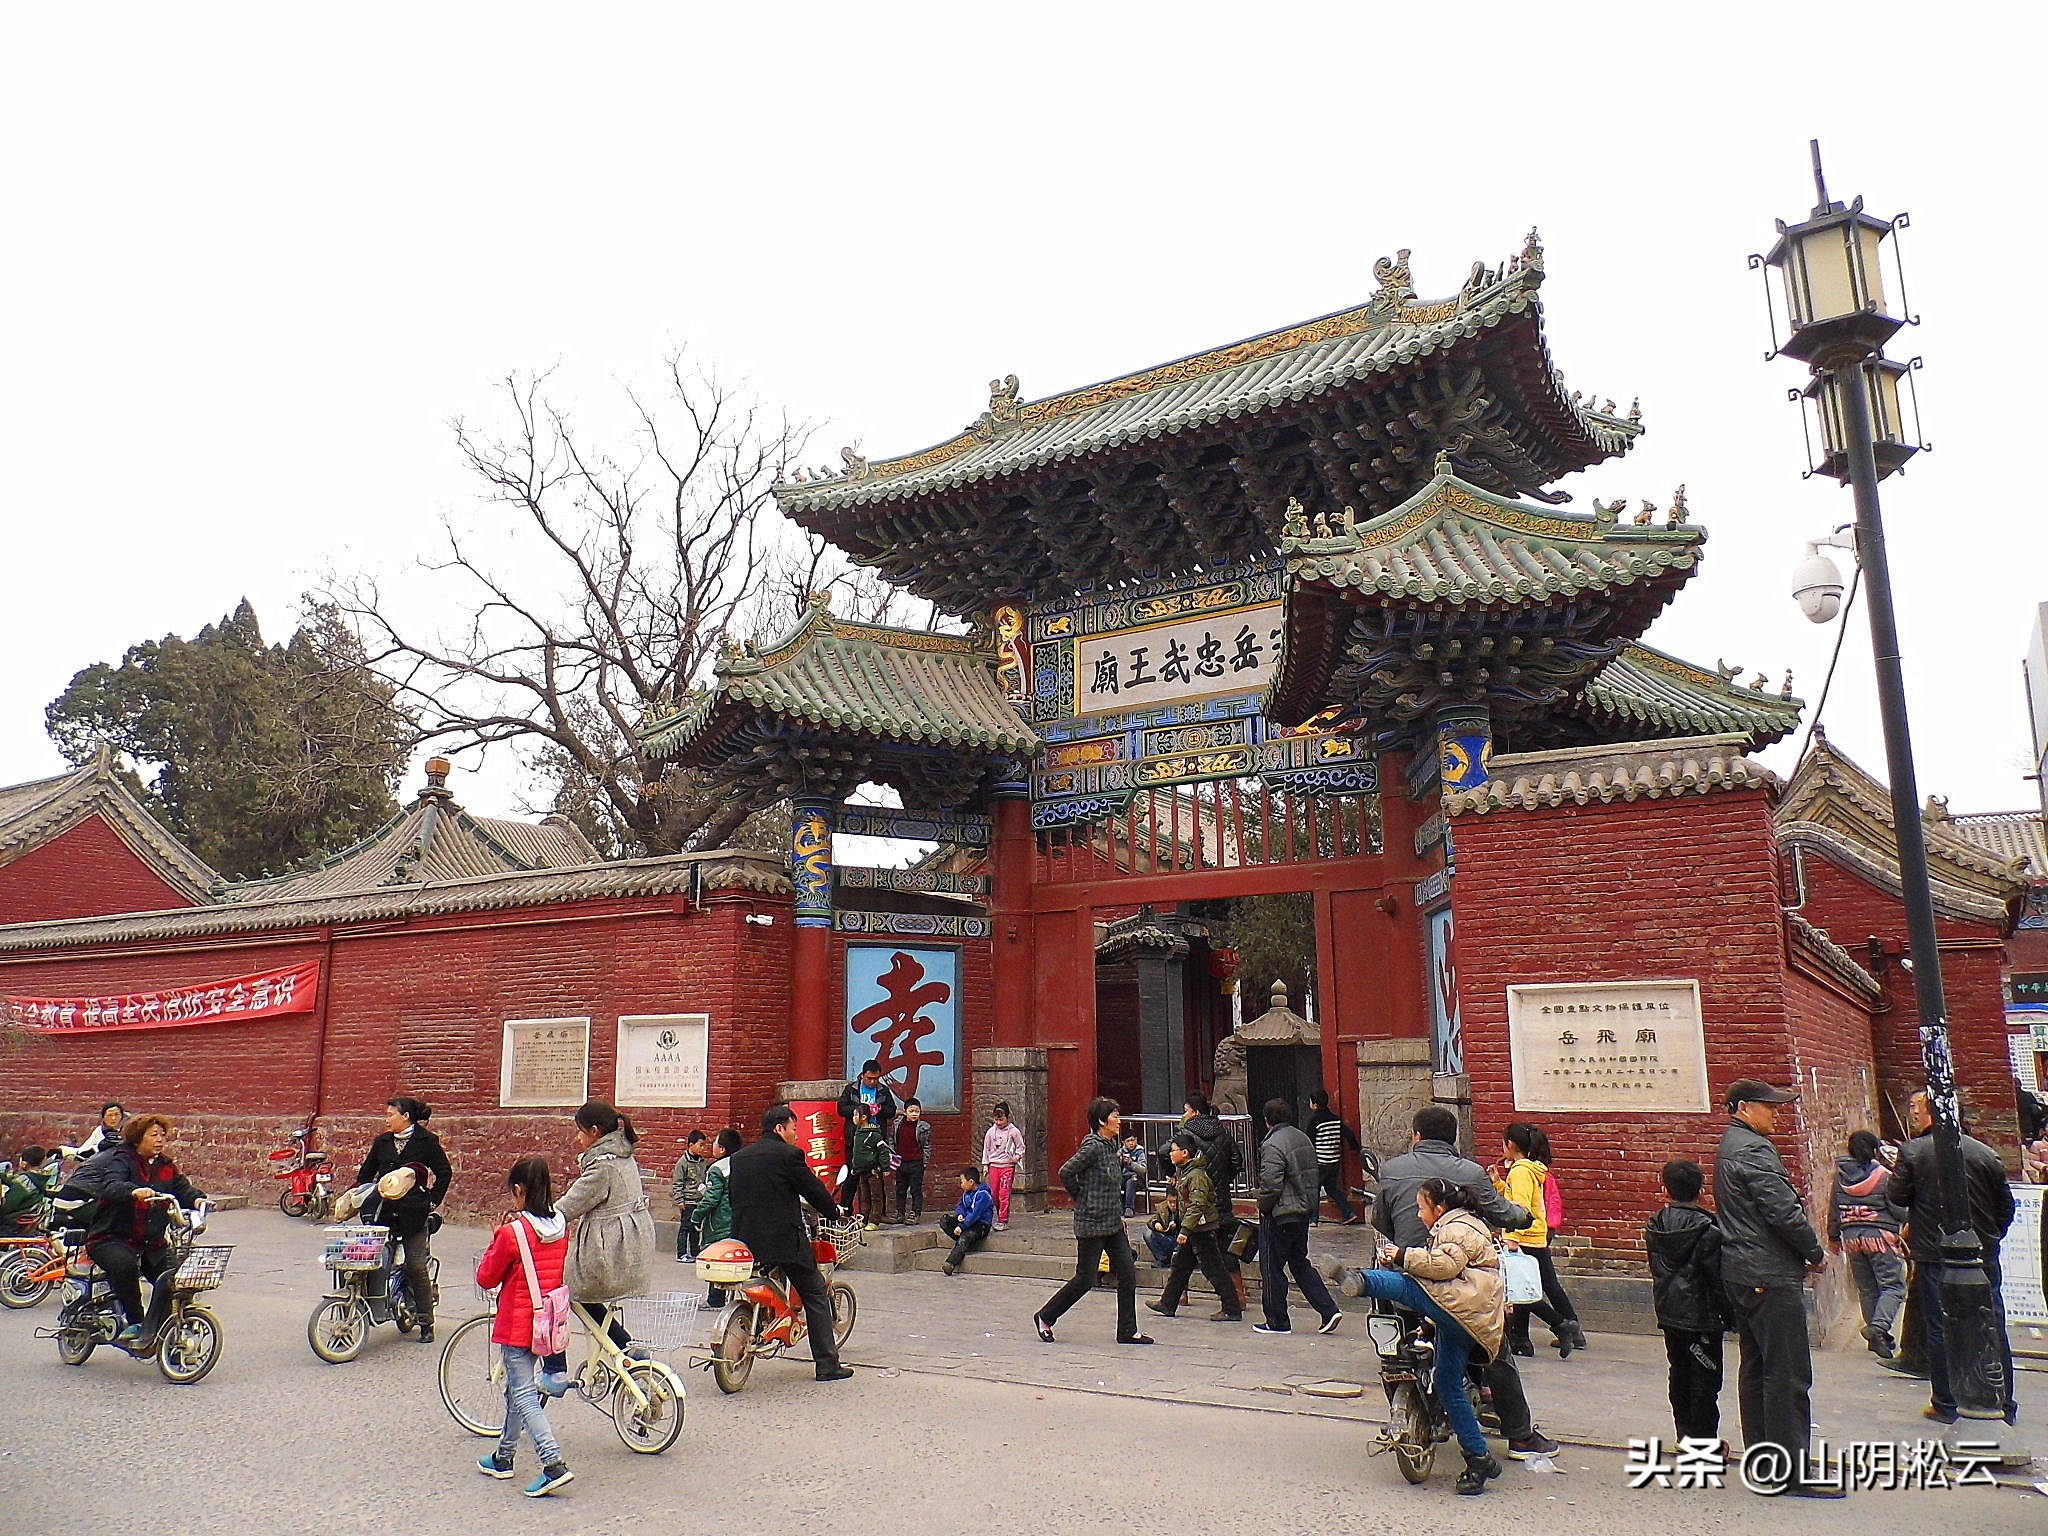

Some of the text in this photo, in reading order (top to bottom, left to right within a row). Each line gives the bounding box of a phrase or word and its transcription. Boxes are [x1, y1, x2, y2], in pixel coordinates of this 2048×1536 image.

[82, 973, 297, 1028] 提高全民消防安全意识
[1558, 1028, 1658, 1045] 岳飛廟
[654, 1053, 681, 1062] AAAA
